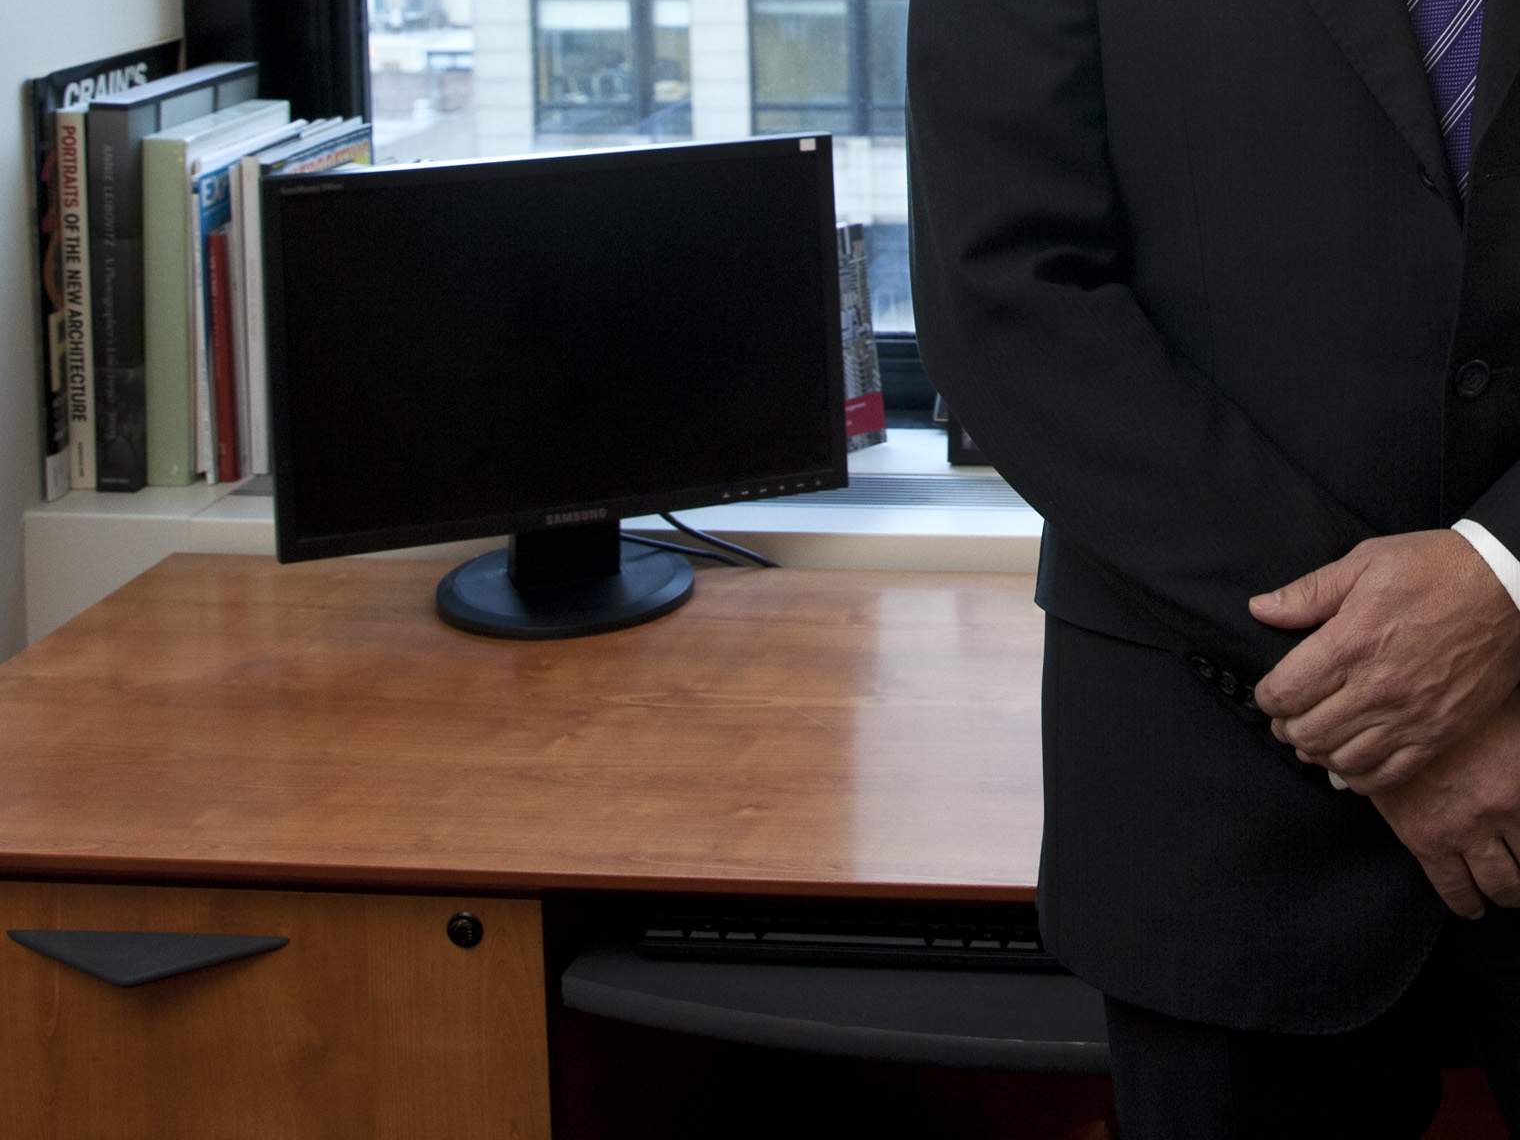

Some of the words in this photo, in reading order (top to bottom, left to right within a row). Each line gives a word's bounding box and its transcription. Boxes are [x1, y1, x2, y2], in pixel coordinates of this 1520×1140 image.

[63, 62, 149, 108] CRAIN'S
[62, 125, 80, 208] PORTRAITS
[65, 213, 81, 234] OF
[65, 239, 82, 265] THE
[66, 269, 84, 304] NEW
[67, 310, 87, 423] ARCHITECTURE
[545, 508, 608, 525] SAMSUNG
